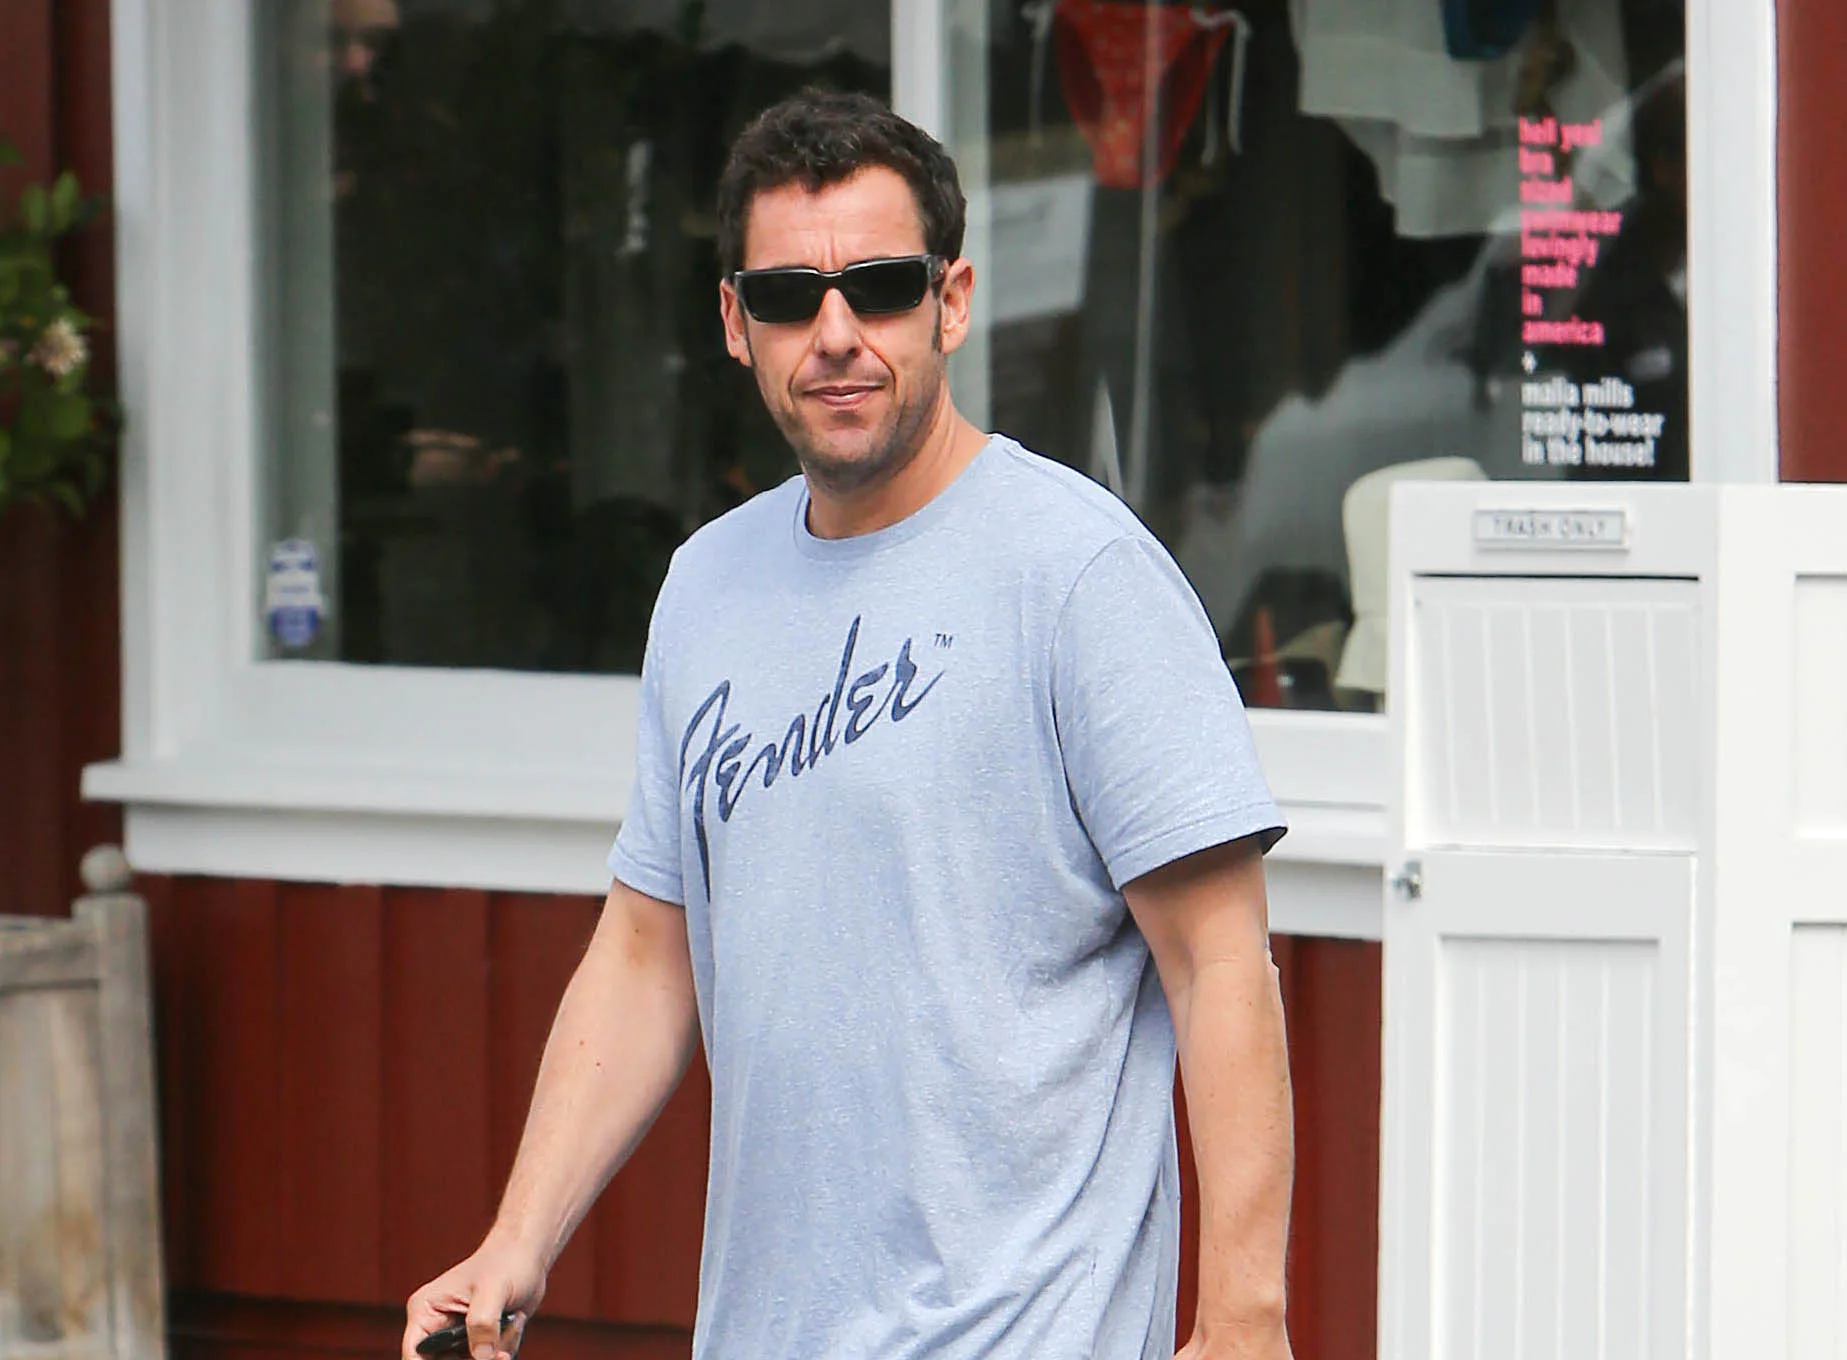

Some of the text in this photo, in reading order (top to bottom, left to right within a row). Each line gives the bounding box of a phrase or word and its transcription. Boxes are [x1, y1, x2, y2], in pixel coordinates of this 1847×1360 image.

[1521, 261, 1577, 288] made
[1521, 288, 1542, 315] in
[1521, 315, 1604, 344] america
[1582, 376, 1634, 408] mills
[1521, 406, 1664, 441] ready-to-wear
[1521, 434, 1655, 466] in the house!
[1493, 517, 1606, 537] TRASH ONLY
[679, 613, 946, 902] Fender
